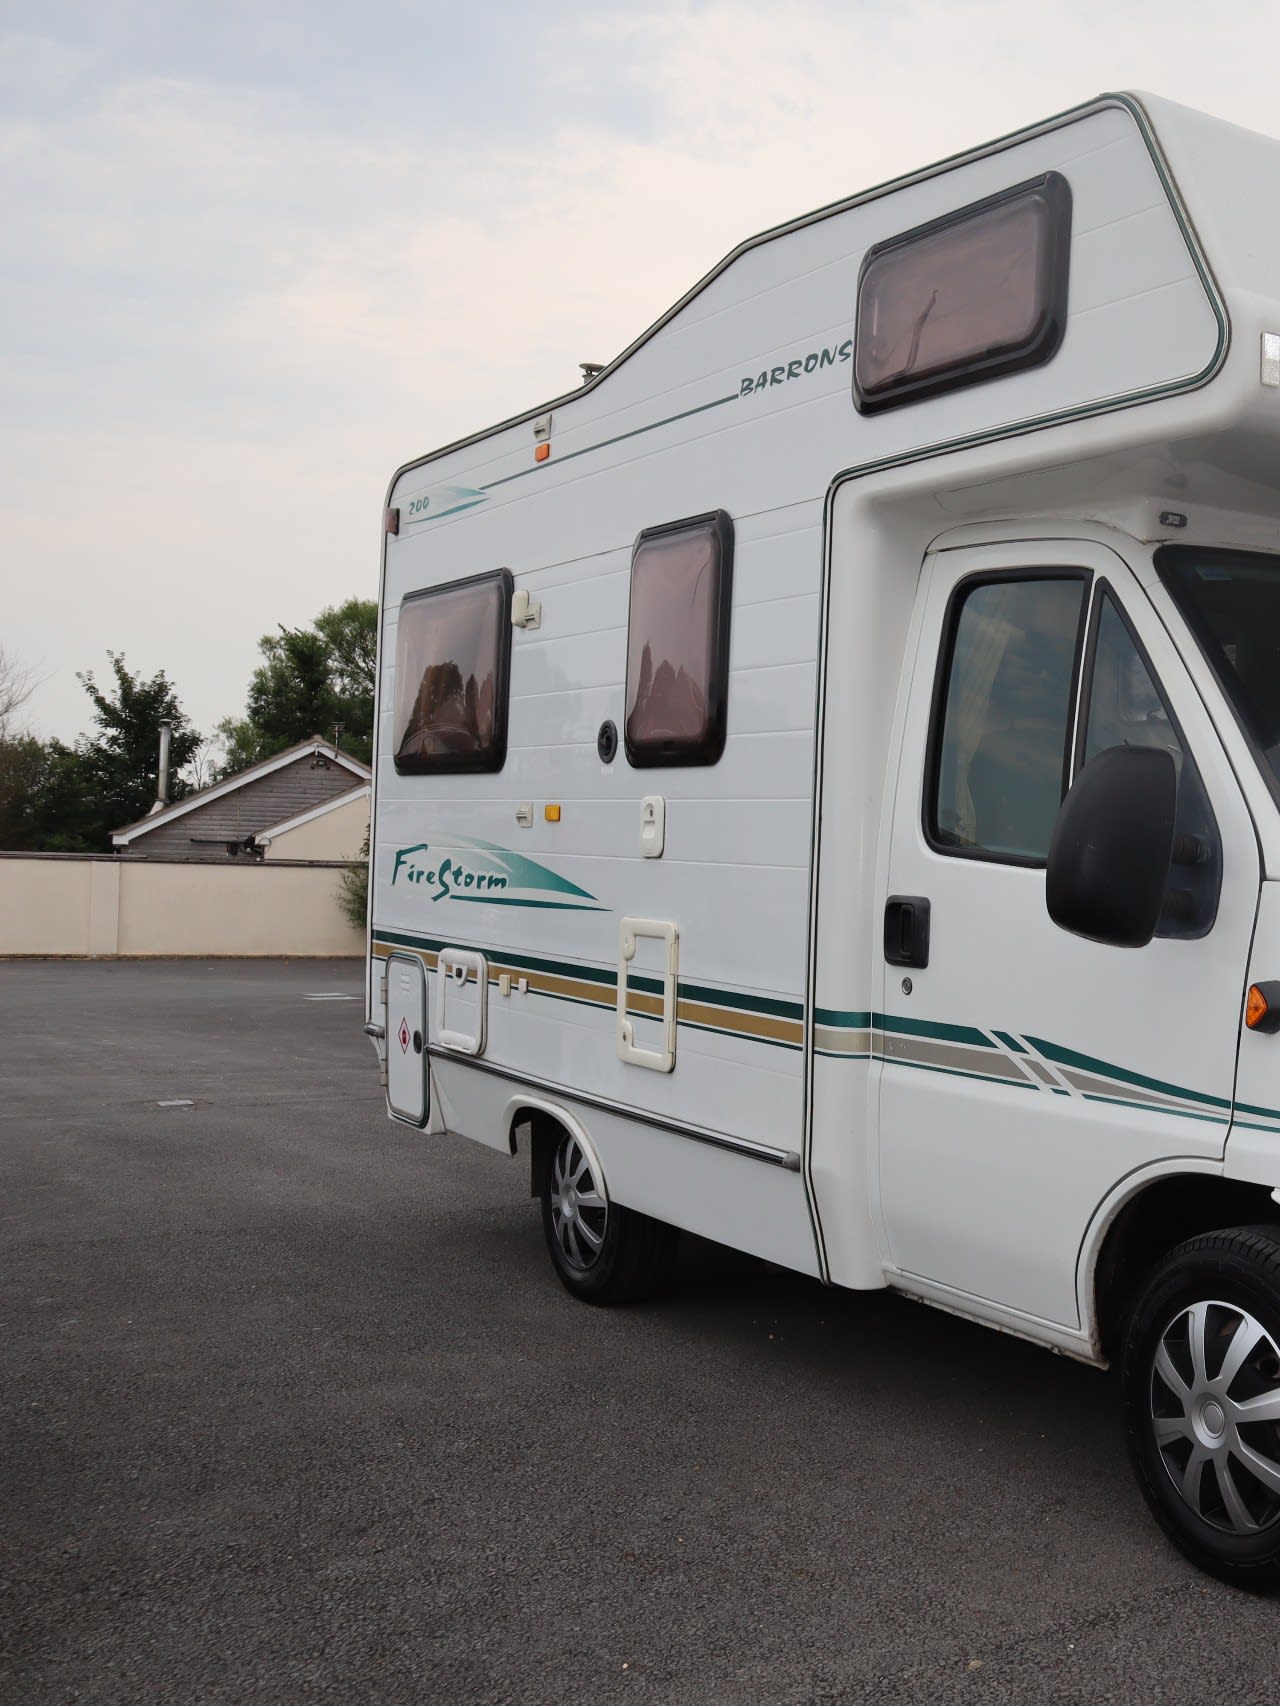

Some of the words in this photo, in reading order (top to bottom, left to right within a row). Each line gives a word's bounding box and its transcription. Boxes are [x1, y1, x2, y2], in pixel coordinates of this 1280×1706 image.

[740, 339, 853, 397] BARRONS
[408, 496, 430, 515] 200
[392, 843, 508, 902] FireStorm
